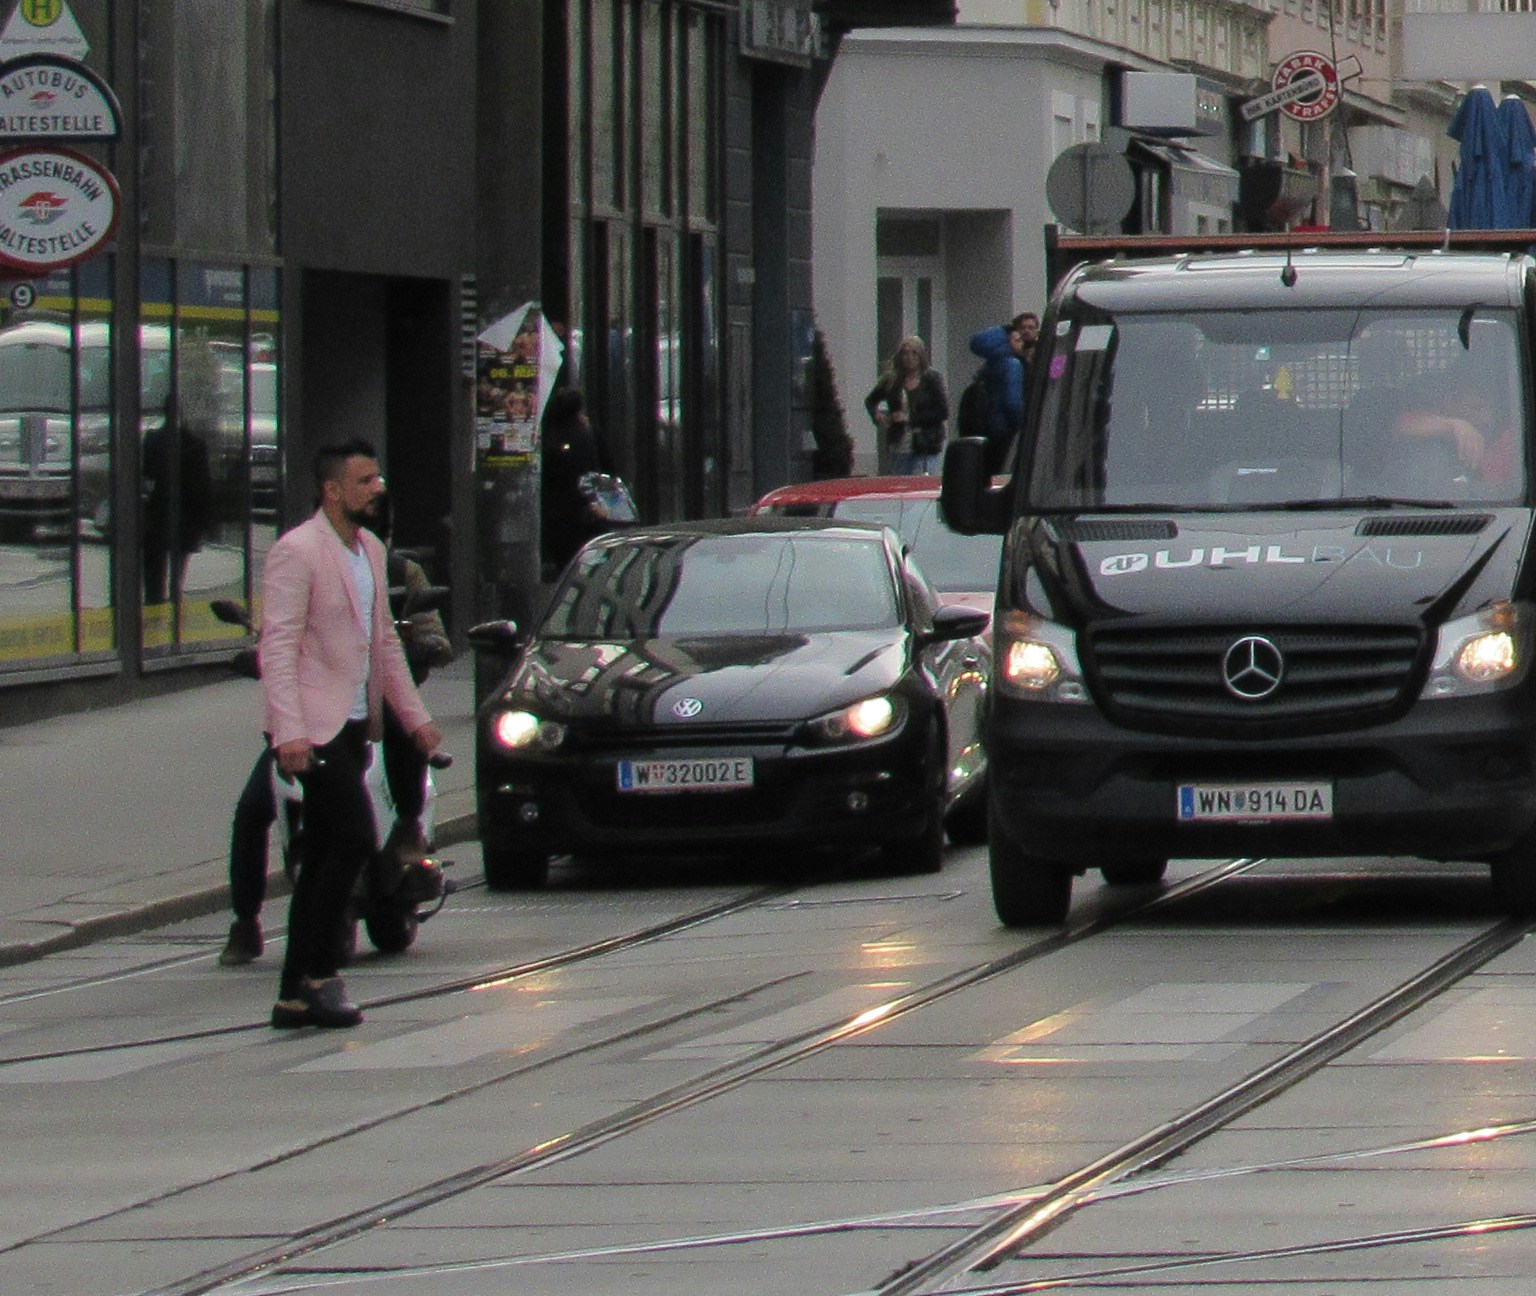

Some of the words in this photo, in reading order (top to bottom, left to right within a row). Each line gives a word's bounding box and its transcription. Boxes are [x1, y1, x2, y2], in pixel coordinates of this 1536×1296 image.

[1278, 55, 1326, 85] TABAK
[2, 70, 88, 98] AUTOBUS
[0, 115, 103, 132] ALTESTELLE
[0, 161, 104, 202] RASSENBAHN
[0, 221, 97, 254] ALTESTELLE
[18, 288, 28, 304] 9
[636, 764, 650, 784] W
[666, 762, 730, 784] 32002
[734, 761, 746, 781] E
[1200, 790, 1231, 813] WN
[1249, 790, 1287, 812] 914
[1294, 789, 1324, 811] DA
